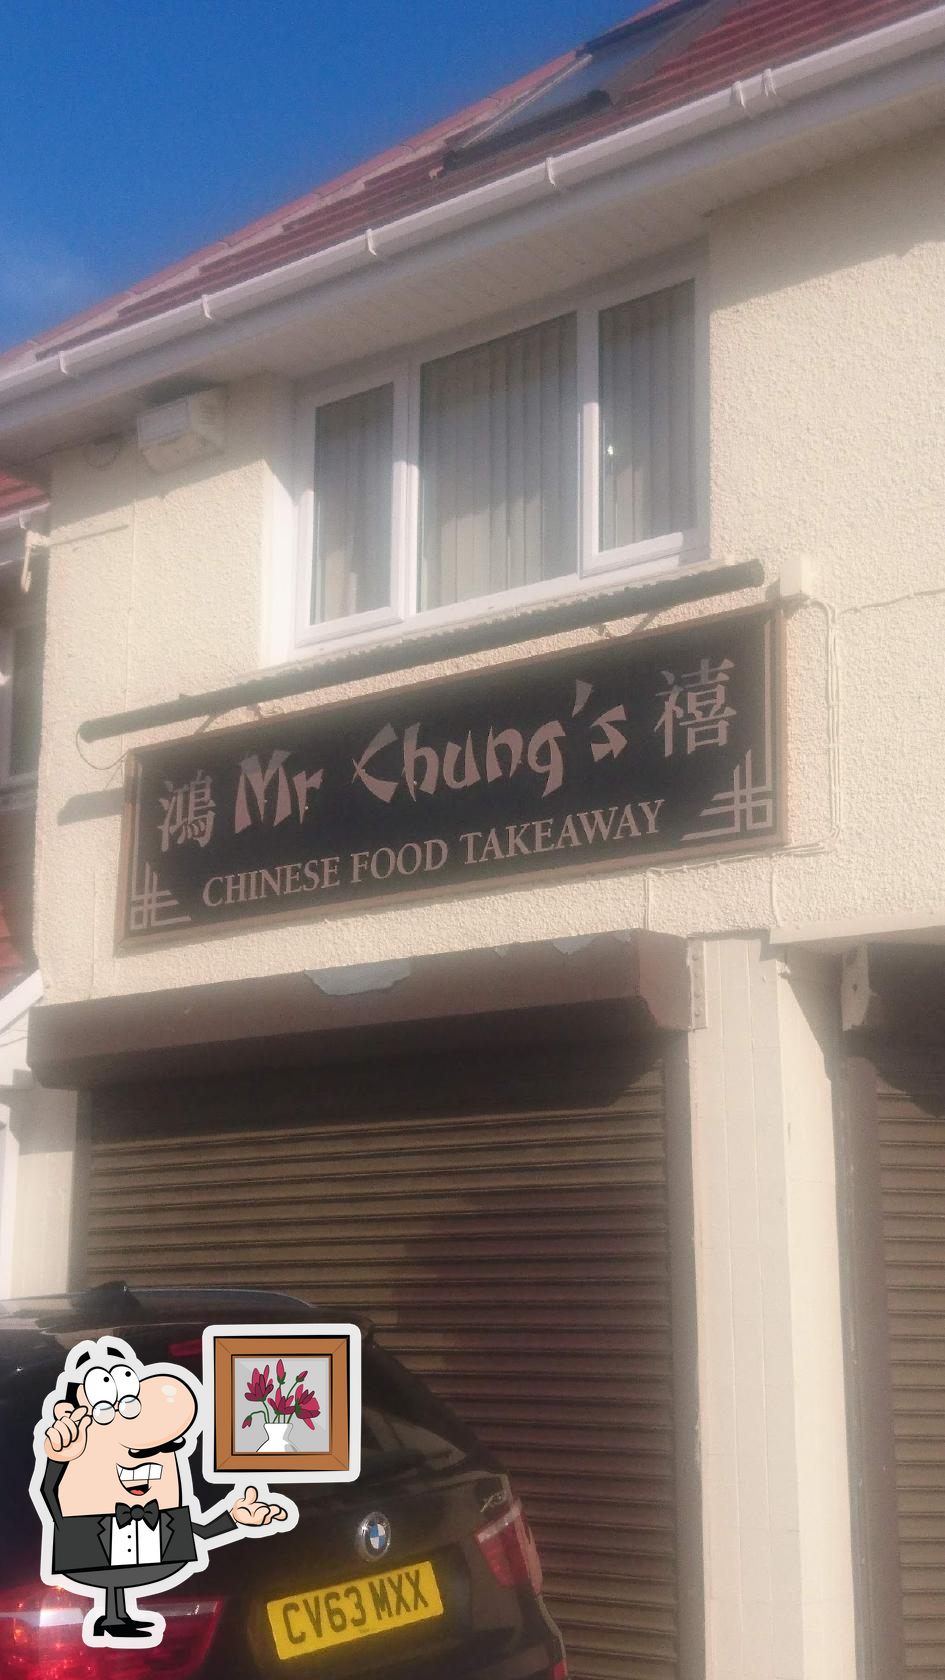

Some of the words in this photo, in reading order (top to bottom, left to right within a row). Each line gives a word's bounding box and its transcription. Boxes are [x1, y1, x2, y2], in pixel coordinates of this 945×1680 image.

[234, 750, 323, 834] Mr
[352, 679, 628, 803] Chung's
[654, 658, 737, 758] 禧
[157, 769, 216, 852] 鴻
[202, 856, 340, 907] CHINESE
[350, 838, 449, 883] FOOD
[459, 799, 665, 865] TAKEAWAY
[282, 1586, 367, 1645] CV63
[368, 1570, 429, 1621] MXX
